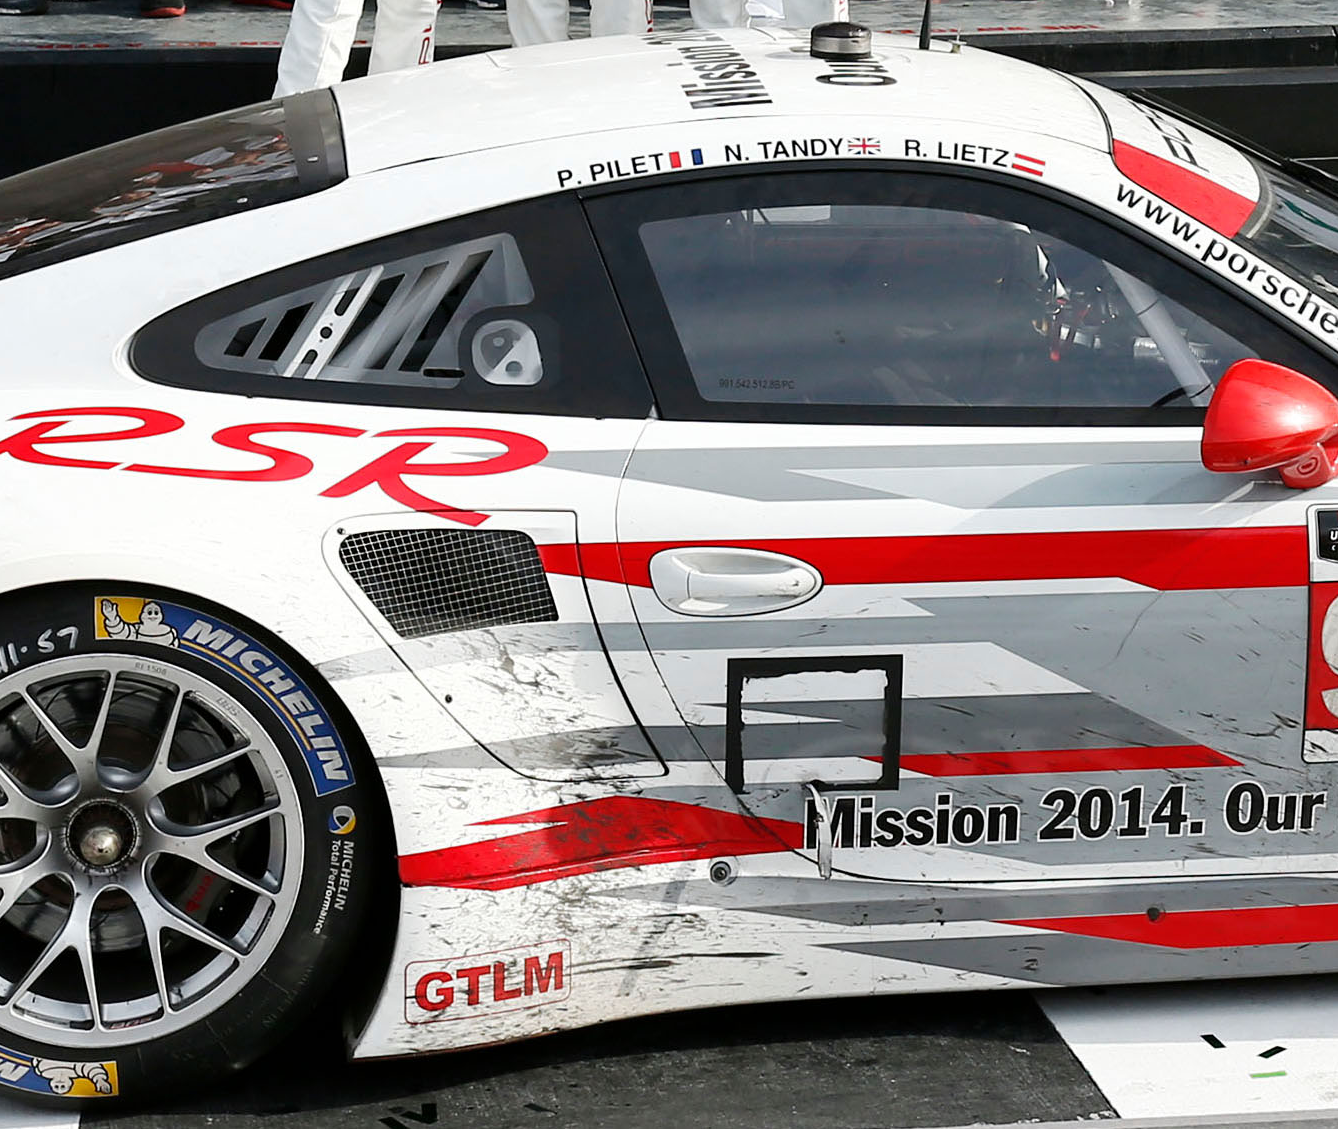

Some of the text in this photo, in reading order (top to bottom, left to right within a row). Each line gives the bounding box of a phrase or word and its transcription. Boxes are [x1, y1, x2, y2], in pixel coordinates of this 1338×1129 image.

[557, 138, 1011, 189] P. PILET N. TANDY R. LIETZ
[182, 619, 348, 782] MICHELIN
[805, 790, 1021, 850] Mission
[1039, 782, 1207, 841] 2014.
[1223, 781, 1327, 834] Our
[313, 839, 343, 936] Total Performance
[334, 840, 356, 912] MICHELIN
[414, 951, 565, 1012] GTLM
